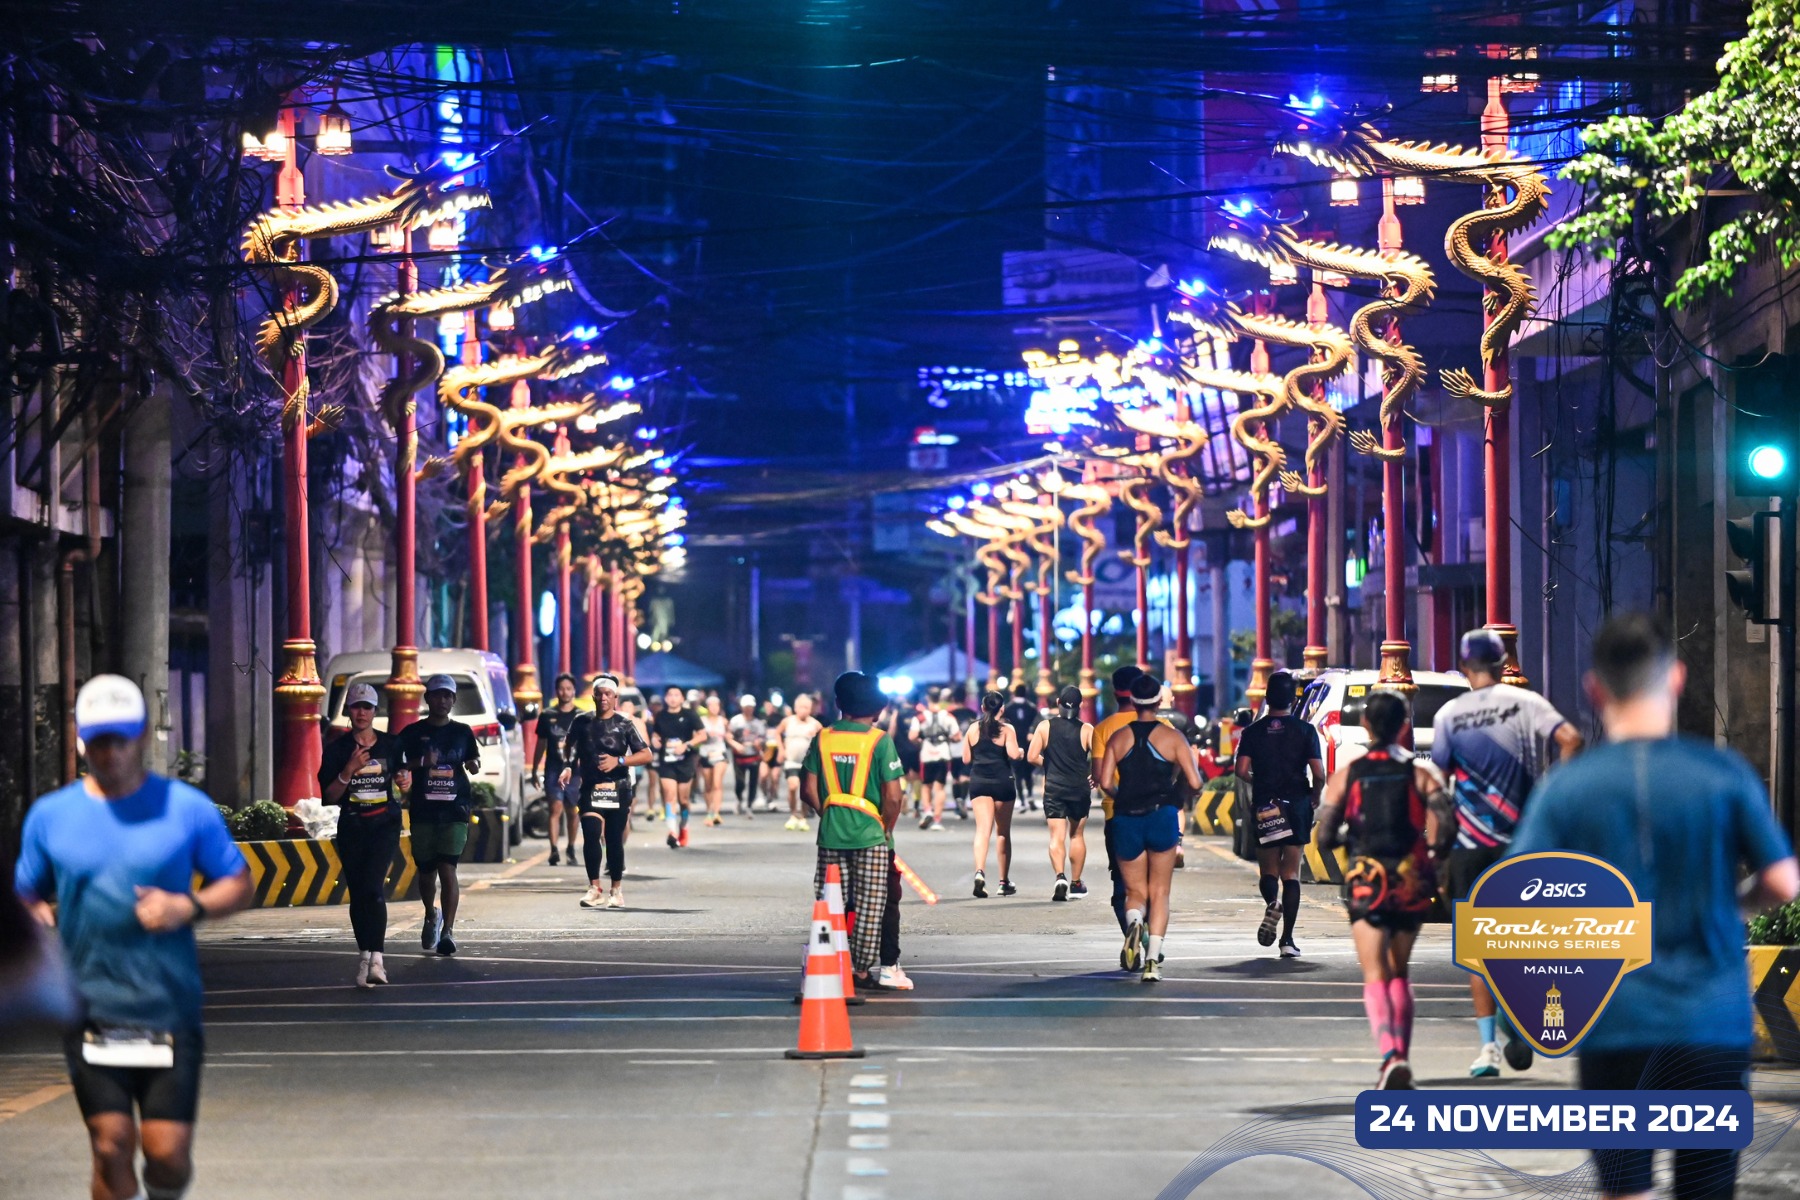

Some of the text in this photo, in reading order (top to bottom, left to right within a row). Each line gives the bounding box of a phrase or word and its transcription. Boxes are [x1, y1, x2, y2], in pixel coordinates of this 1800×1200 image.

[1453, 707, 1499, 723] SOUTH
[1453, 717, 1495, 734] PLUS
[351, 776, 385, 784] D420909
[1258, 817, 1285, 829] C420700
